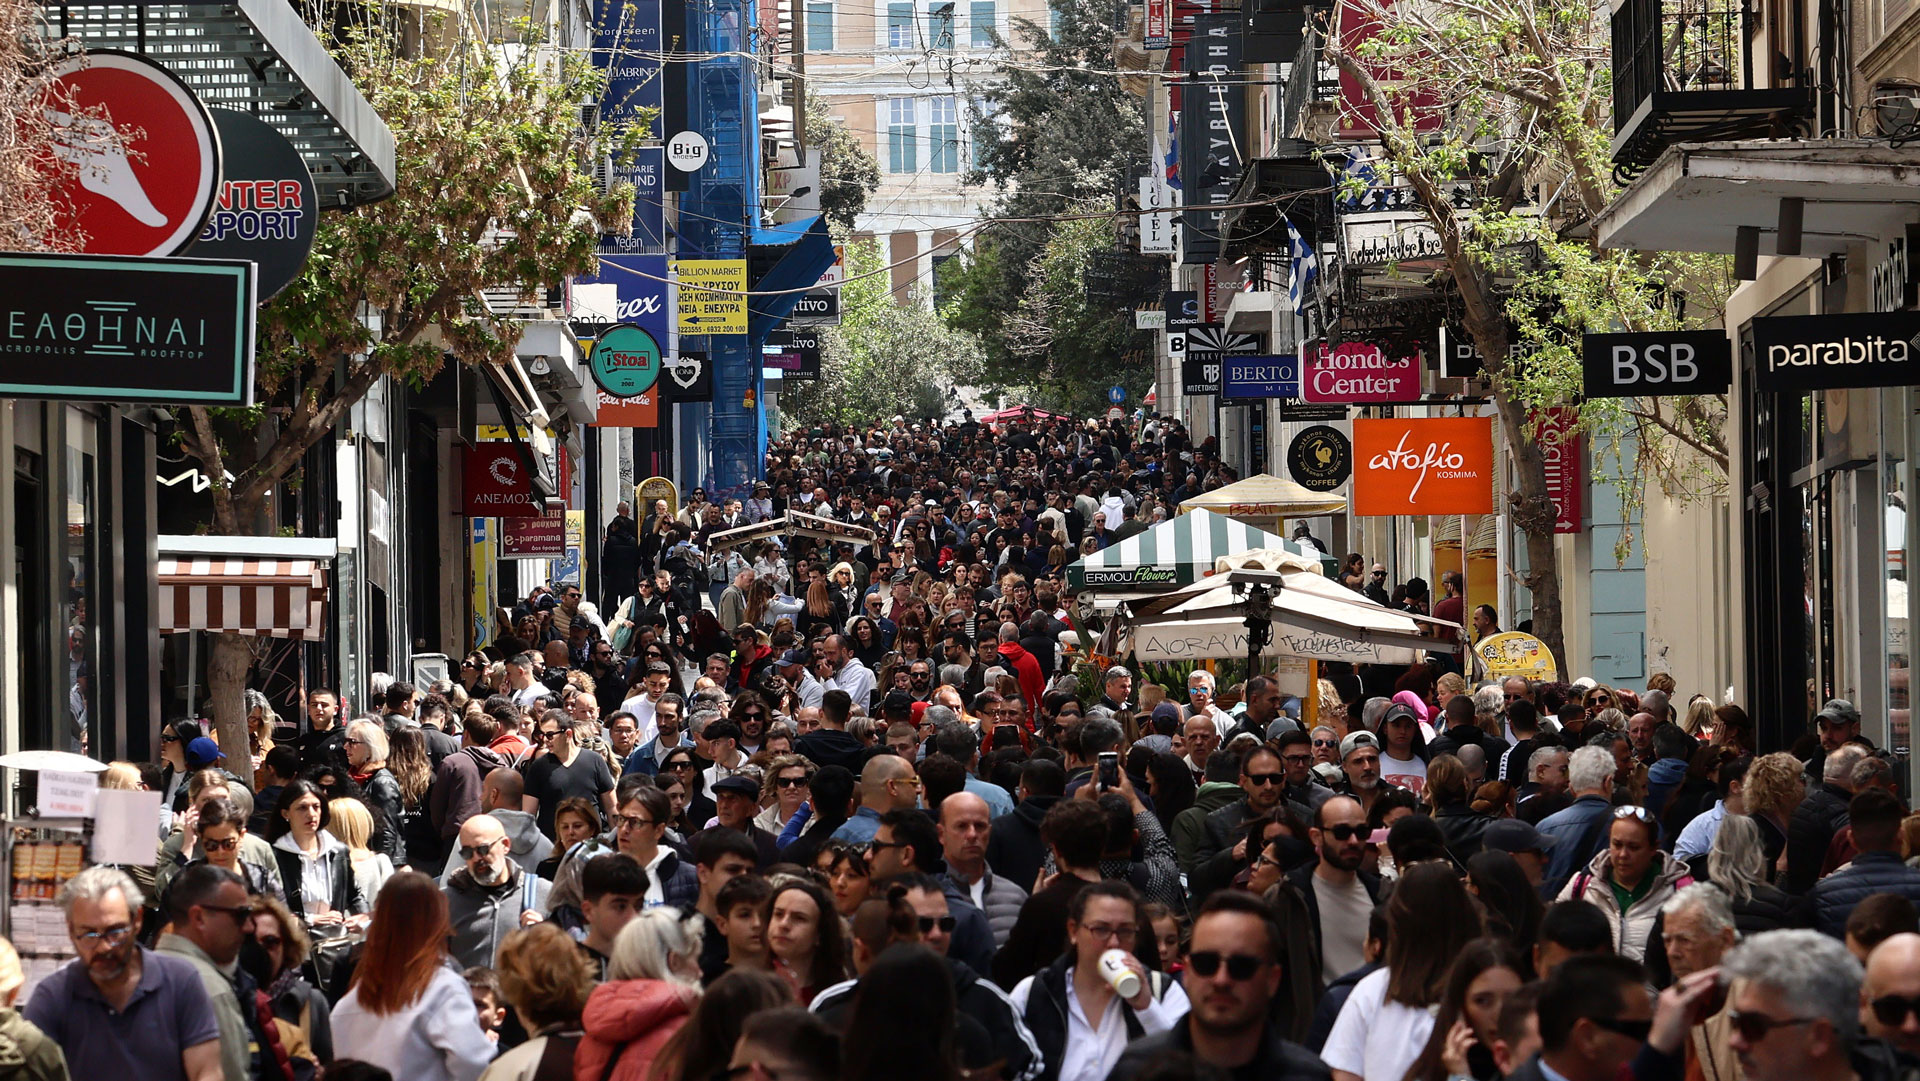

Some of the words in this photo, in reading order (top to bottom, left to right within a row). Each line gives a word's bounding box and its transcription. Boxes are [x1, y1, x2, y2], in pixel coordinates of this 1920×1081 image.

[673, 143, 701, 158] Big
[218, 180, 303, 210] NTER
[711, 267, 743, 276] MARKET
[820, 273, 835, 281] an
[1217, 281, 1244, 289] ecco
[703, 303, 741, 314] ΕΝΕΧΥΡΑ
[796, 297, 828, 311] tivo
[140, 349, 204, 359] ROOFTOP
[1188, 353, 1219, 361] FUNKY
[1768, 335, 1909, 373] parabita
[1612, 343, 1699, 385] BSB
[1231, 366, 1292, 381] BERTO
[1313, 370, 1401, 395] Center
[1286, 398, 1303, 406] MA
[1436, 471, 1478, 479] KOSMIMA
[474, 493, 533, 504] ΑΝΕΜΟΣ
[1085, 571, 1133, 583] ERMOU
[1134, 567, 1177, 583] Flower
